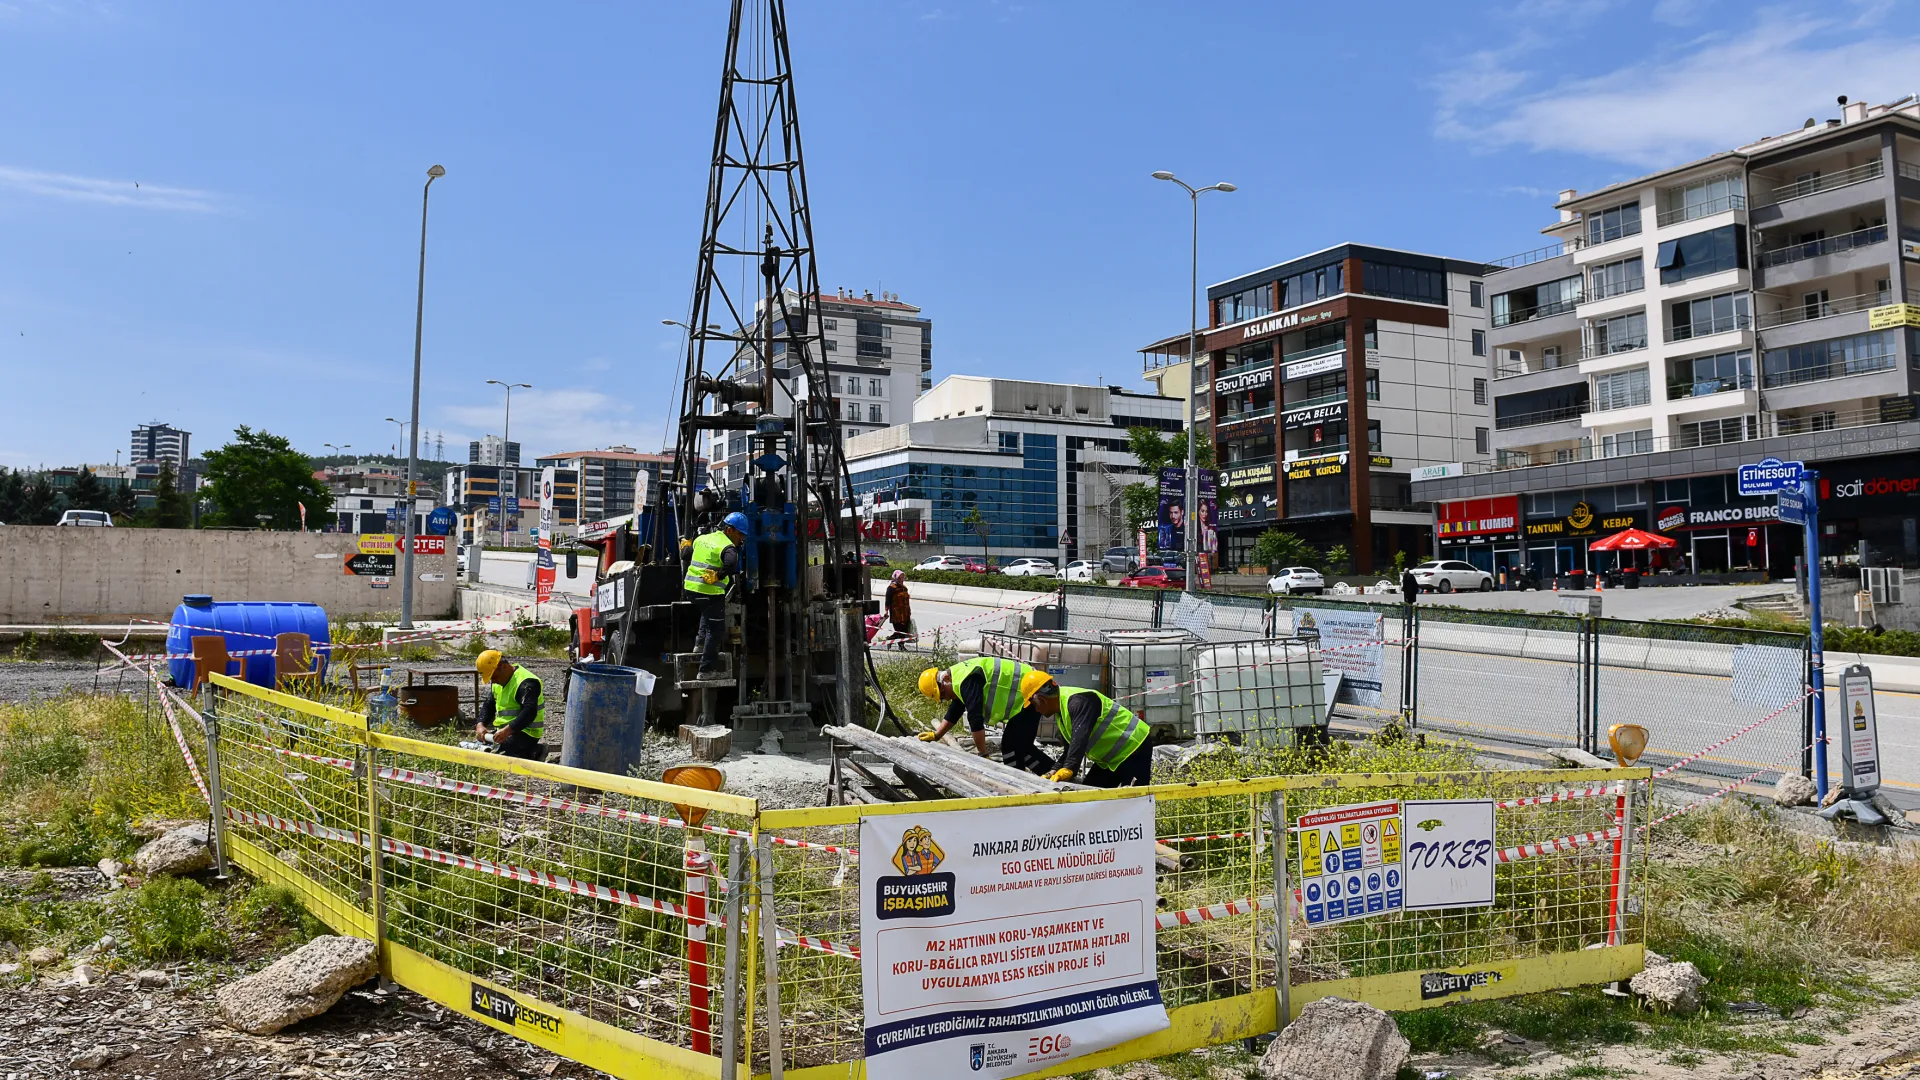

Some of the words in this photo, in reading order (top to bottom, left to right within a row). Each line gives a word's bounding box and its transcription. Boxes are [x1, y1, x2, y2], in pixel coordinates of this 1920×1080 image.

[1244, 313, 1298, 338] ASLANKAN
[1216, 380, 1238, 392] Ebru
[1239, 370, 1272, 387] İNANIR
[1313, 406, 1342, 418] BELLA
[1231, 470, 1247, 479] ALFA
[1248, 465, 1272, 477] KUŞAĞI
[1289, 467, 1312, 480] MÜZİK
[1316, 464, 1341, 476] KURSU
[1743, 467, 1796, 480] ETİMESGUT
[1574, 508, 1586, 517] 312
[1790, 500, 1803, 510] SOKAK
[1664, 512, 1684, 522] FRANCO
[1690, 509, 1742, 523] FRANCO
[1744, 506, 1779, 519] BURG
[858, 520, 926, 540] KOLEJİ
[1440, 519, 1478, 534] FANATİK
[1527, 520, 1563, 534] TANTUNİ
[1603, 518, 1634, 528] KEBAP
[1658, 518, 1686, 530] BURGER
[1311, 814, 1336, 823] GÜVENLİĞİ
[1337, 810, 1373, 820] TALİMATLARINA
[972, 841, 1019, 857] ANKARA
[1022, 831, 1086, 852] BÜYÜKŞEHİR
[1088, 823, 1143, 845] BELEDİYESİ
[1002, 861, 1022, 875] EGO
[1024, 857, 1055, 872] GENEL
[1057, 849, 1116, 869] MÜDÜRLÜĞÜ
[1409, 840, 1491, 870] TOKER
[970, 884, 996, 895] ULAŞIM
[997, 880, 1033, 892] PLANLAMA
[1034, 880, 1042, 888] VE
[1043, 876, 1062, 887] RAYLI
[1062, 872, 1084, 884] SİSTEM
[1086, 870, 1107, 882] DAİRESİ
[1108, 866, 1144, 880] BAŞKANLIĞI
[884, 882, 948, 895] BÜYÜKŞEHİR
[884, 894, 948, 911] İŞBAŞINDA
[926, 940, 945, 952] M2
[949, 933, 996, 951] HATTININ
[999, 919, 1090, 943] KORU-YAŞAMKENT
[1092, 918, 1104, 930] VE
[892, 955, 978, 975] KORU-BAĞLICA
[980, 952, 1008, 966] RAYLI
[1011, 944, 1046, 961] SİSTEM
[1048, 939, 1089, 955] UZATMA
[1091, 932, 1130, 948] HATLARI
[922, 974, 1000, 990] UYGULAMAYA
[1002, 969, 1025, 982] ESAS
[1027, 962, 1055, 977] KESİN
[1057, 957, 1088, 972] PROJE
[1093, 952, 1105, 968] İŞİ
[876, 1026, 926, 1048] ÇEVREMİZE
[927, 1012, 986, 1034] VERDİĞİMİZ
[988, 1006, 1064, 1027] RAHATSIZLIKTAN
[1065, 1000, 1096, 1016] DOLAYI
[1096, 994, 1119, 1010] ÖZÜR
[1120, 988, 1154, 1005] DİLERİZ.
[986, 1060, 1012, 1068] BELEDİYESİ
[987, 1052, 1017, 1062] BÜYÜKŞEHİR
